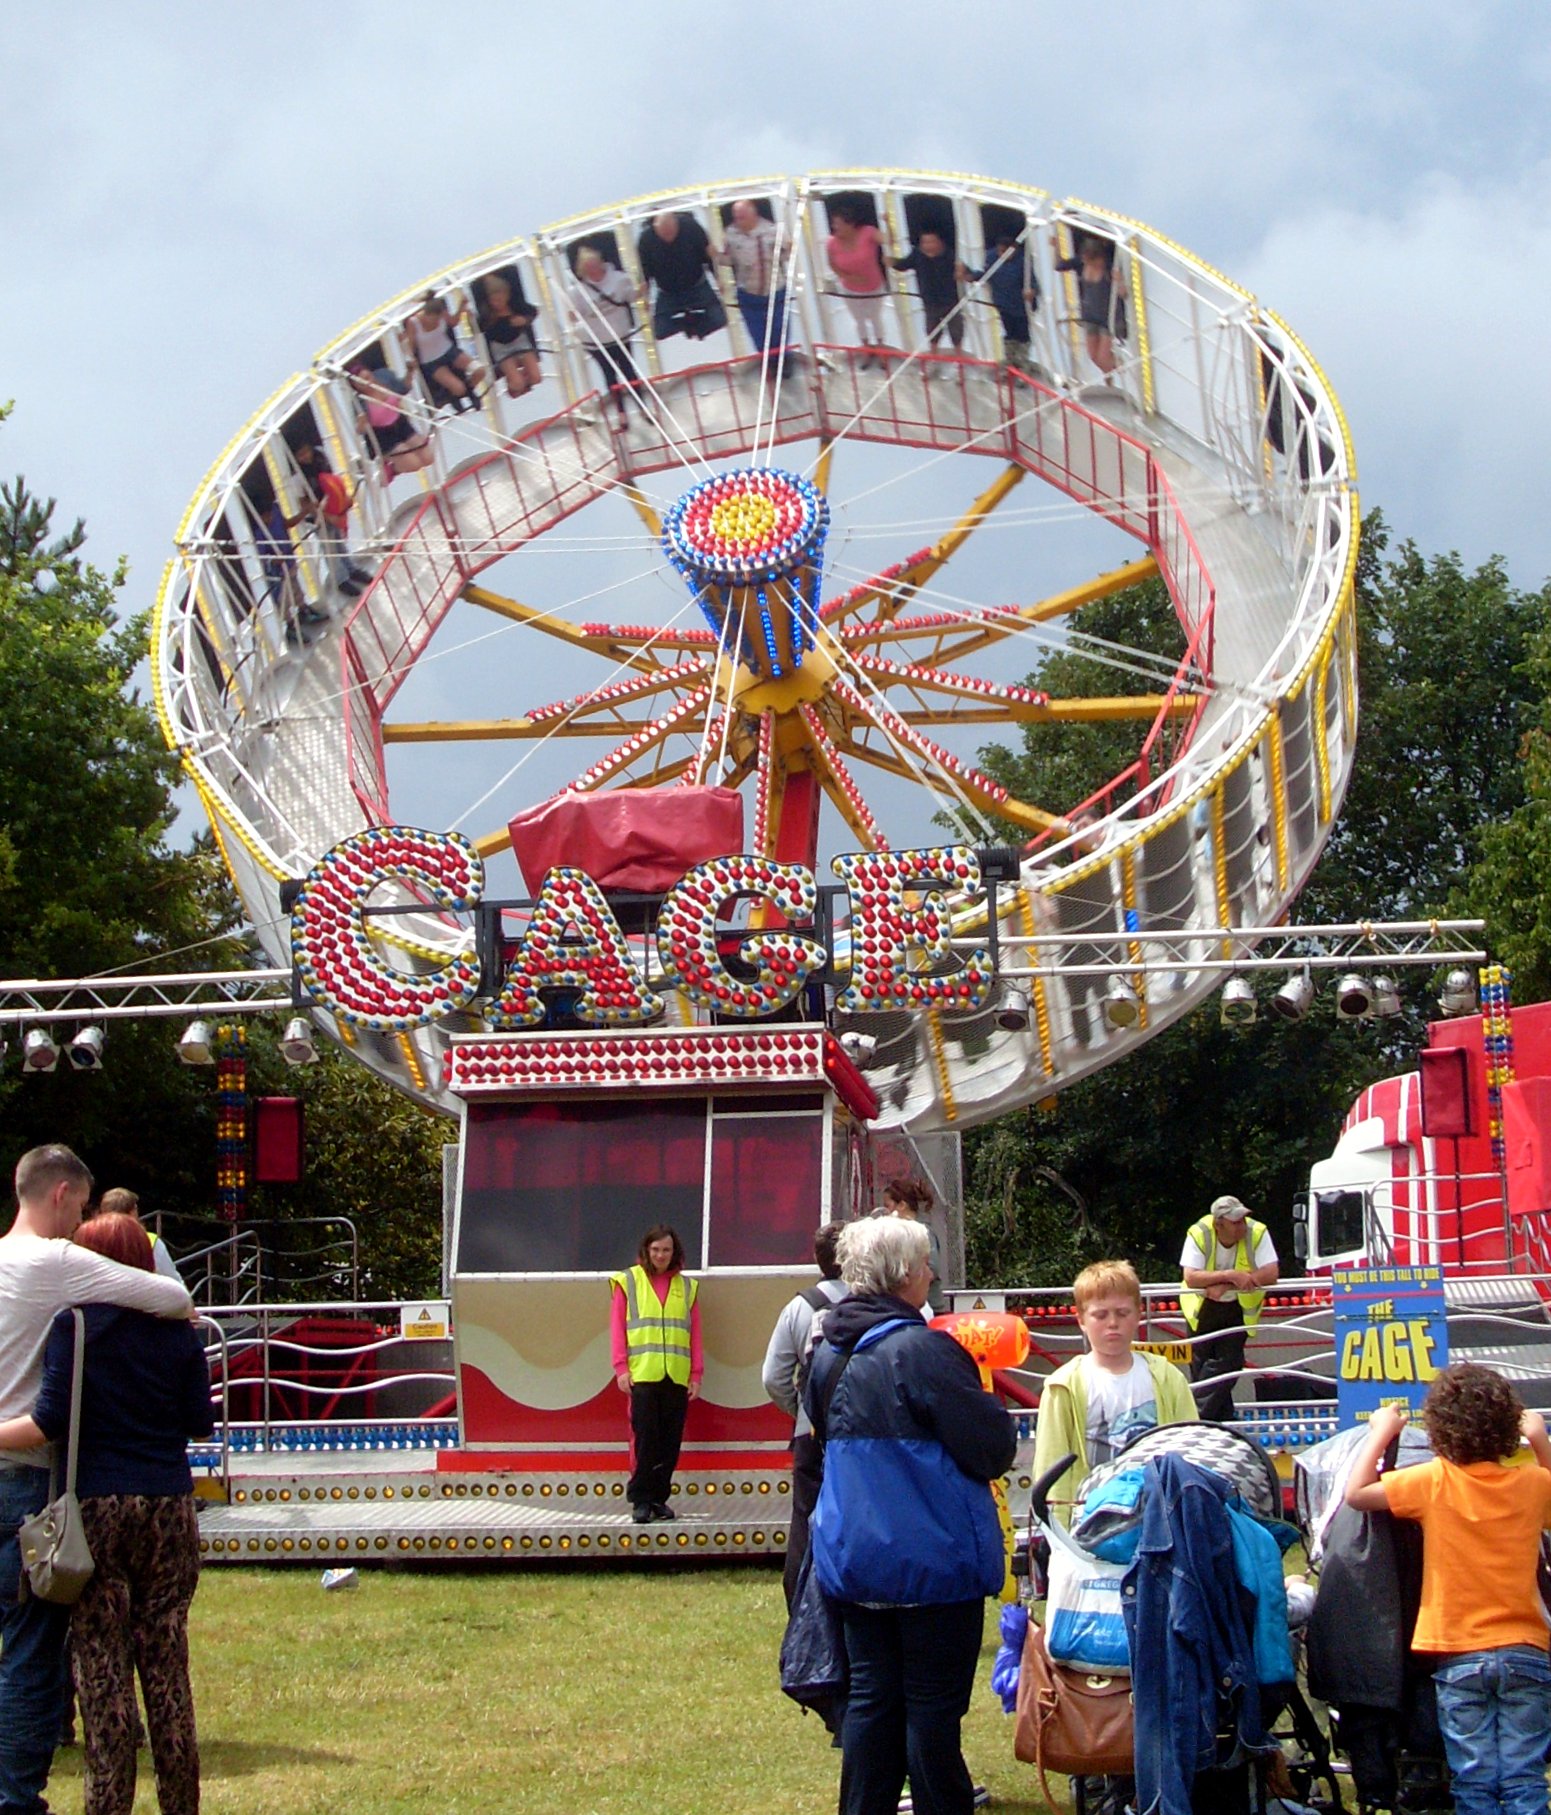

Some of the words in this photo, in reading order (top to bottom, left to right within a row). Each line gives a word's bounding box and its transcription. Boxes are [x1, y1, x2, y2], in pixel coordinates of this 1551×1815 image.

[291, 825, 997, 1030] CAGE
[1348, 1270, 1367, 1283] MUST
[1368, 1270, 1378, 1282] BE
[1379, 1269, 1395, 1282] THIS
[1396, 1268, 1412, 1281] TALL
[1413, 1268, 1422, 1280] TO
[1367, 1299, 1393, 1323] THE
[1172, 1345, 1187, 1360] IN
[1341, 1317, 1438, 1382] CAGE
